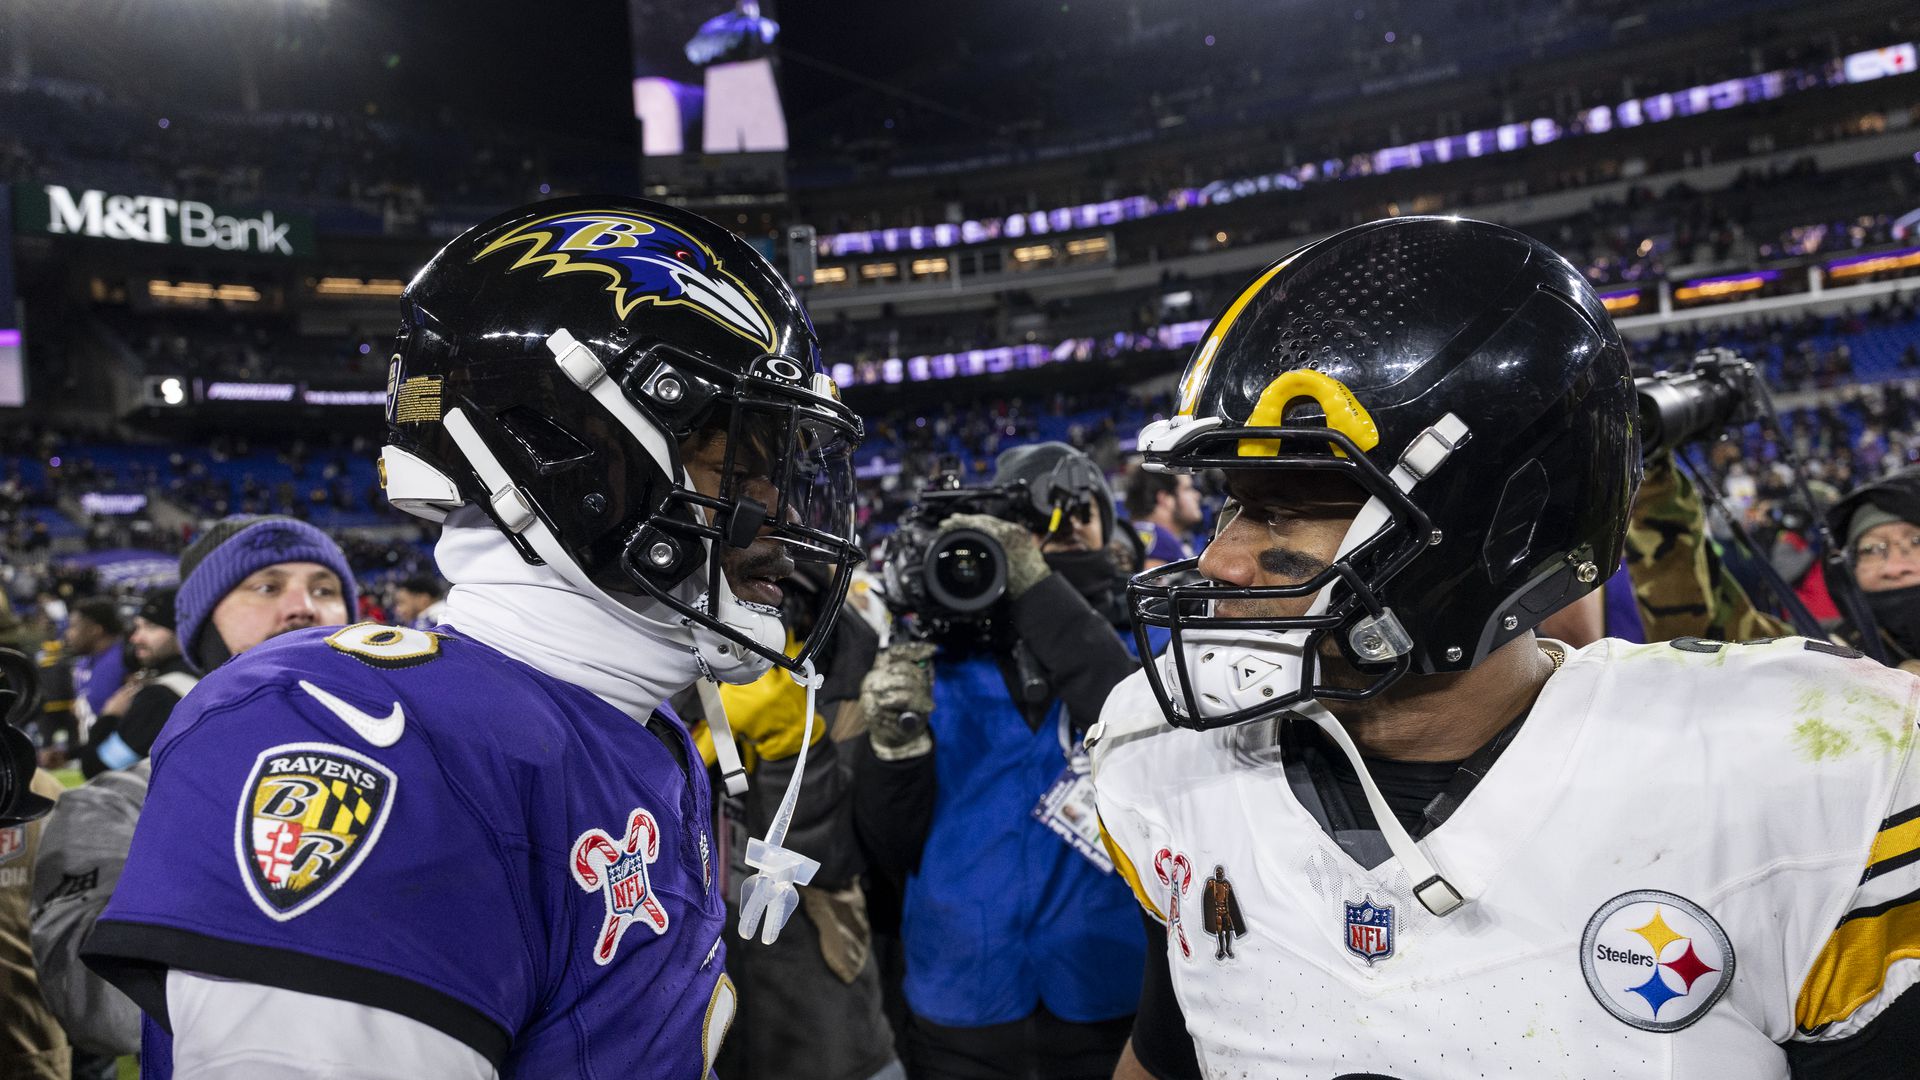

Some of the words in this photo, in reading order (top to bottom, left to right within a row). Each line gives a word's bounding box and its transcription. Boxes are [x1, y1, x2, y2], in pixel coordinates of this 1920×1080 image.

[45, 185, 179, 244] M&T
[180, 201, 293, 255] Bank
[549, 216, 655, 251] B
[270, 757, 377, 790] RAVENS
[263, 777, 321, 818] B
[290, 832, 345, 879] R
[613, 873, 645, 909] NFL
[1351, 925, 1386, 954] NFL
[1597, 944, 1654, 967] Steelers
